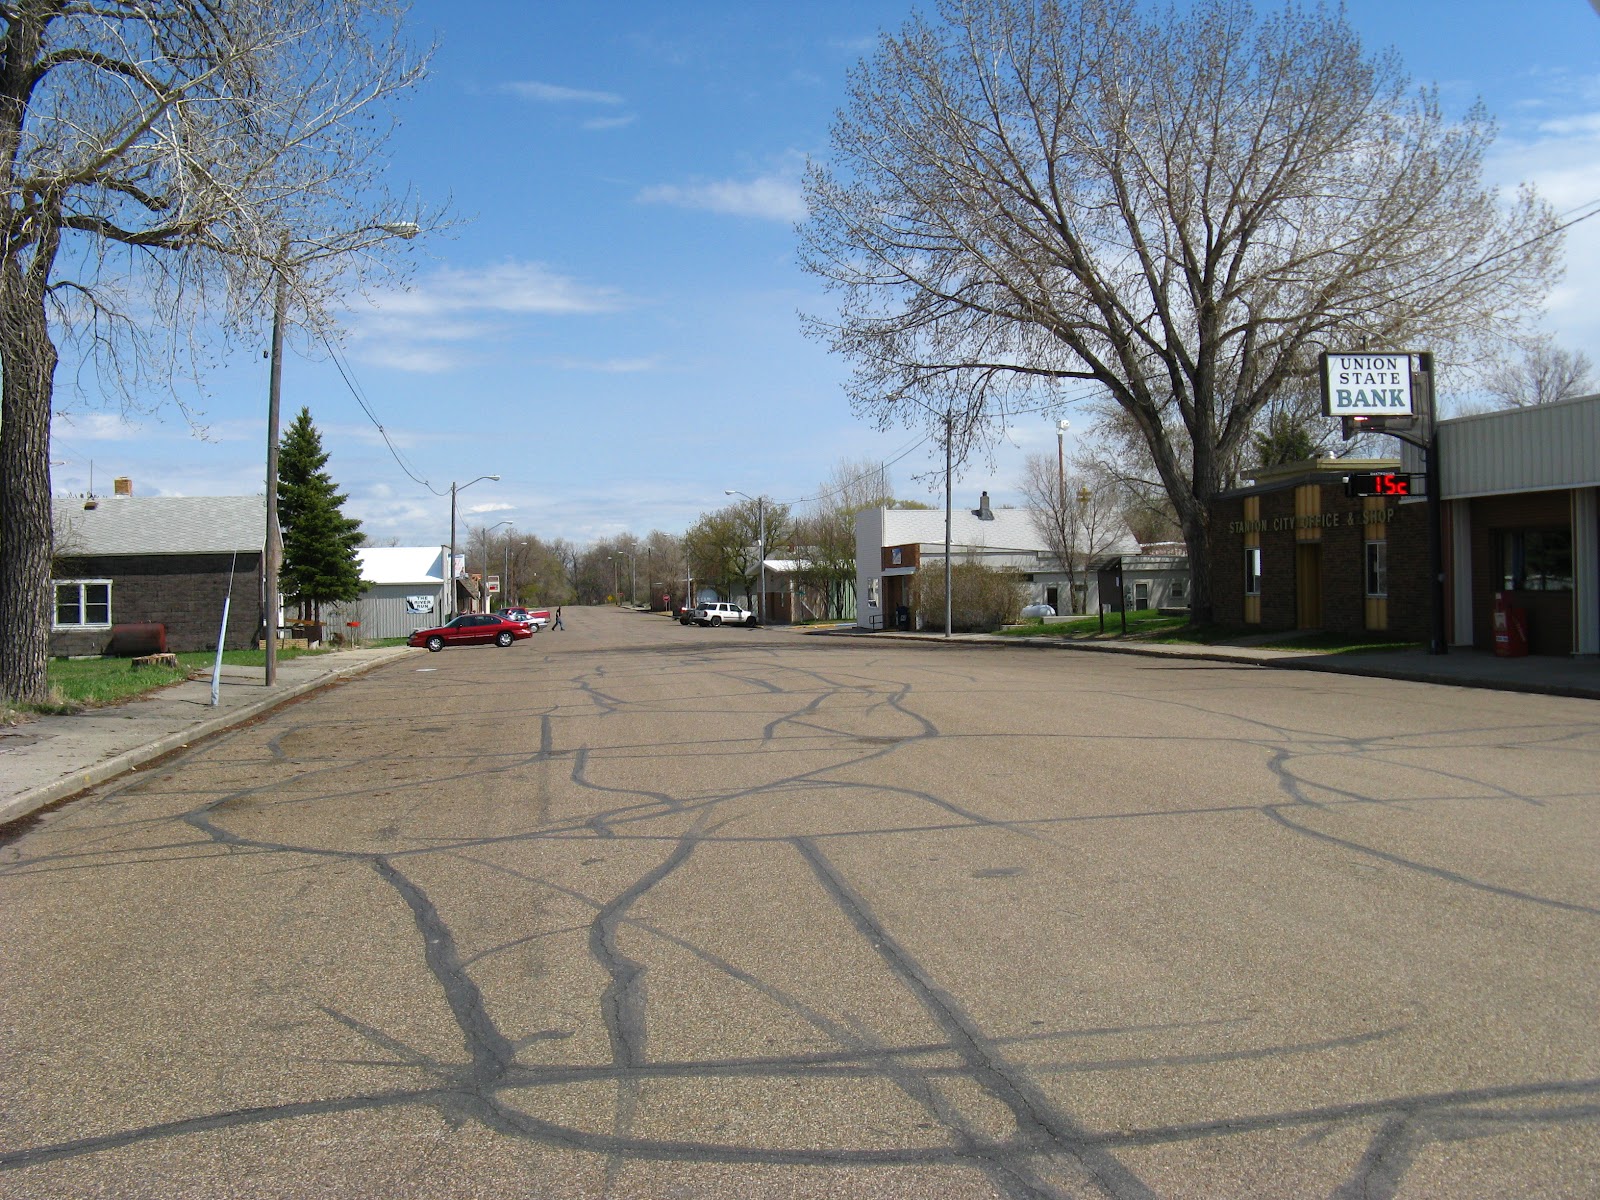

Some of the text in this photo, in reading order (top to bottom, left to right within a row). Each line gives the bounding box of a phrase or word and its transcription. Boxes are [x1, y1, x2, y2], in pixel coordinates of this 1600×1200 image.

[1341, 358, 1397, 370] UNION
[1339, 372, 1400, 385] STATE
[1336, 388, 1405, 408] BANK
[1229, 518, 1267, 534] STANTON
[1273, 516, 1294, 531] CITY
[1303, 512, 1339, 529] OFFICE
[1363, 508, 1394, 524] SHOP
